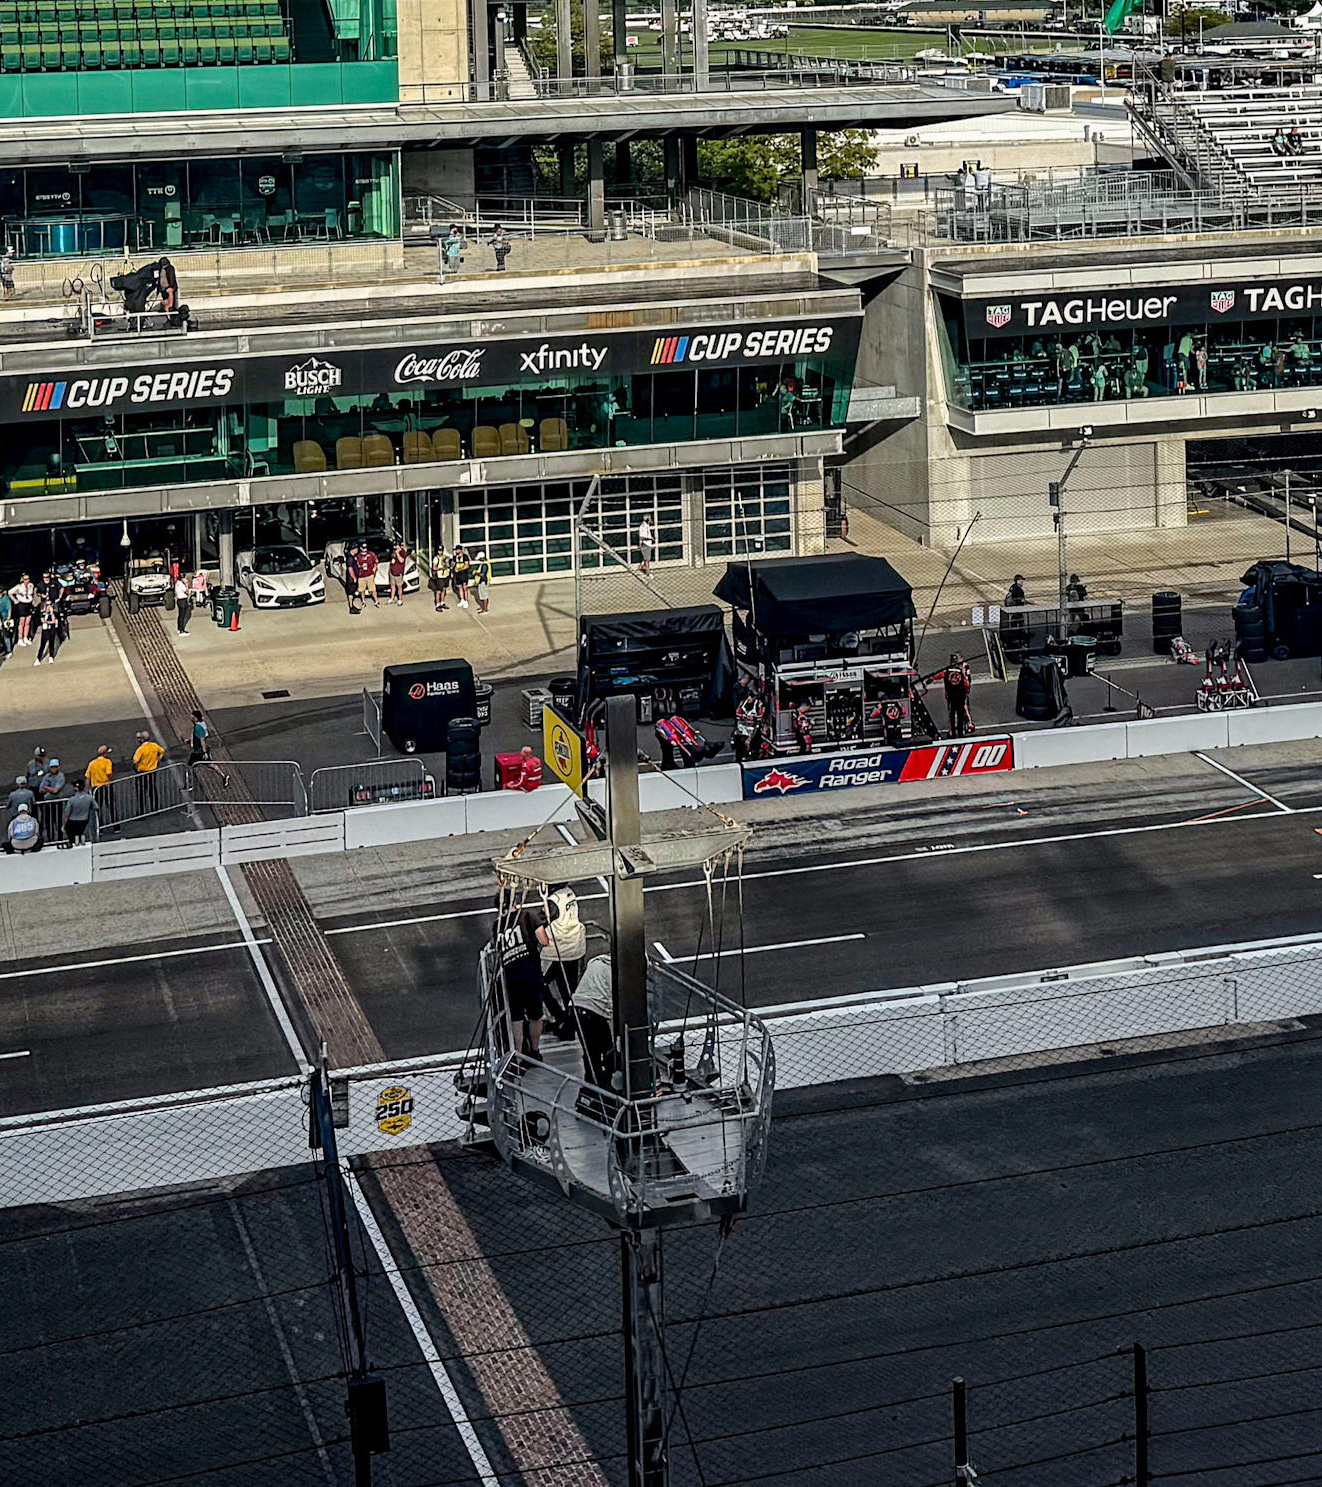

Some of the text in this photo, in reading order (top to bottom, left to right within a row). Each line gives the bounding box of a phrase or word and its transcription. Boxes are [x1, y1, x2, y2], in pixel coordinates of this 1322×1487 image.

[688, 327, 834, 362] CUP SERIES
[520, 343, 608, 374] xfinity
[66, 368, 235, 408] CUP SERIES
[284, 368, 342, 390] BUSCH
[426, 681, 459, 692] Haas
[828, 754, 882, 772] Road
[971, 745, 1008, 768] 00
[819, 769, 893, 789] Ranger
[375, 1098, 414, 1122] 250
